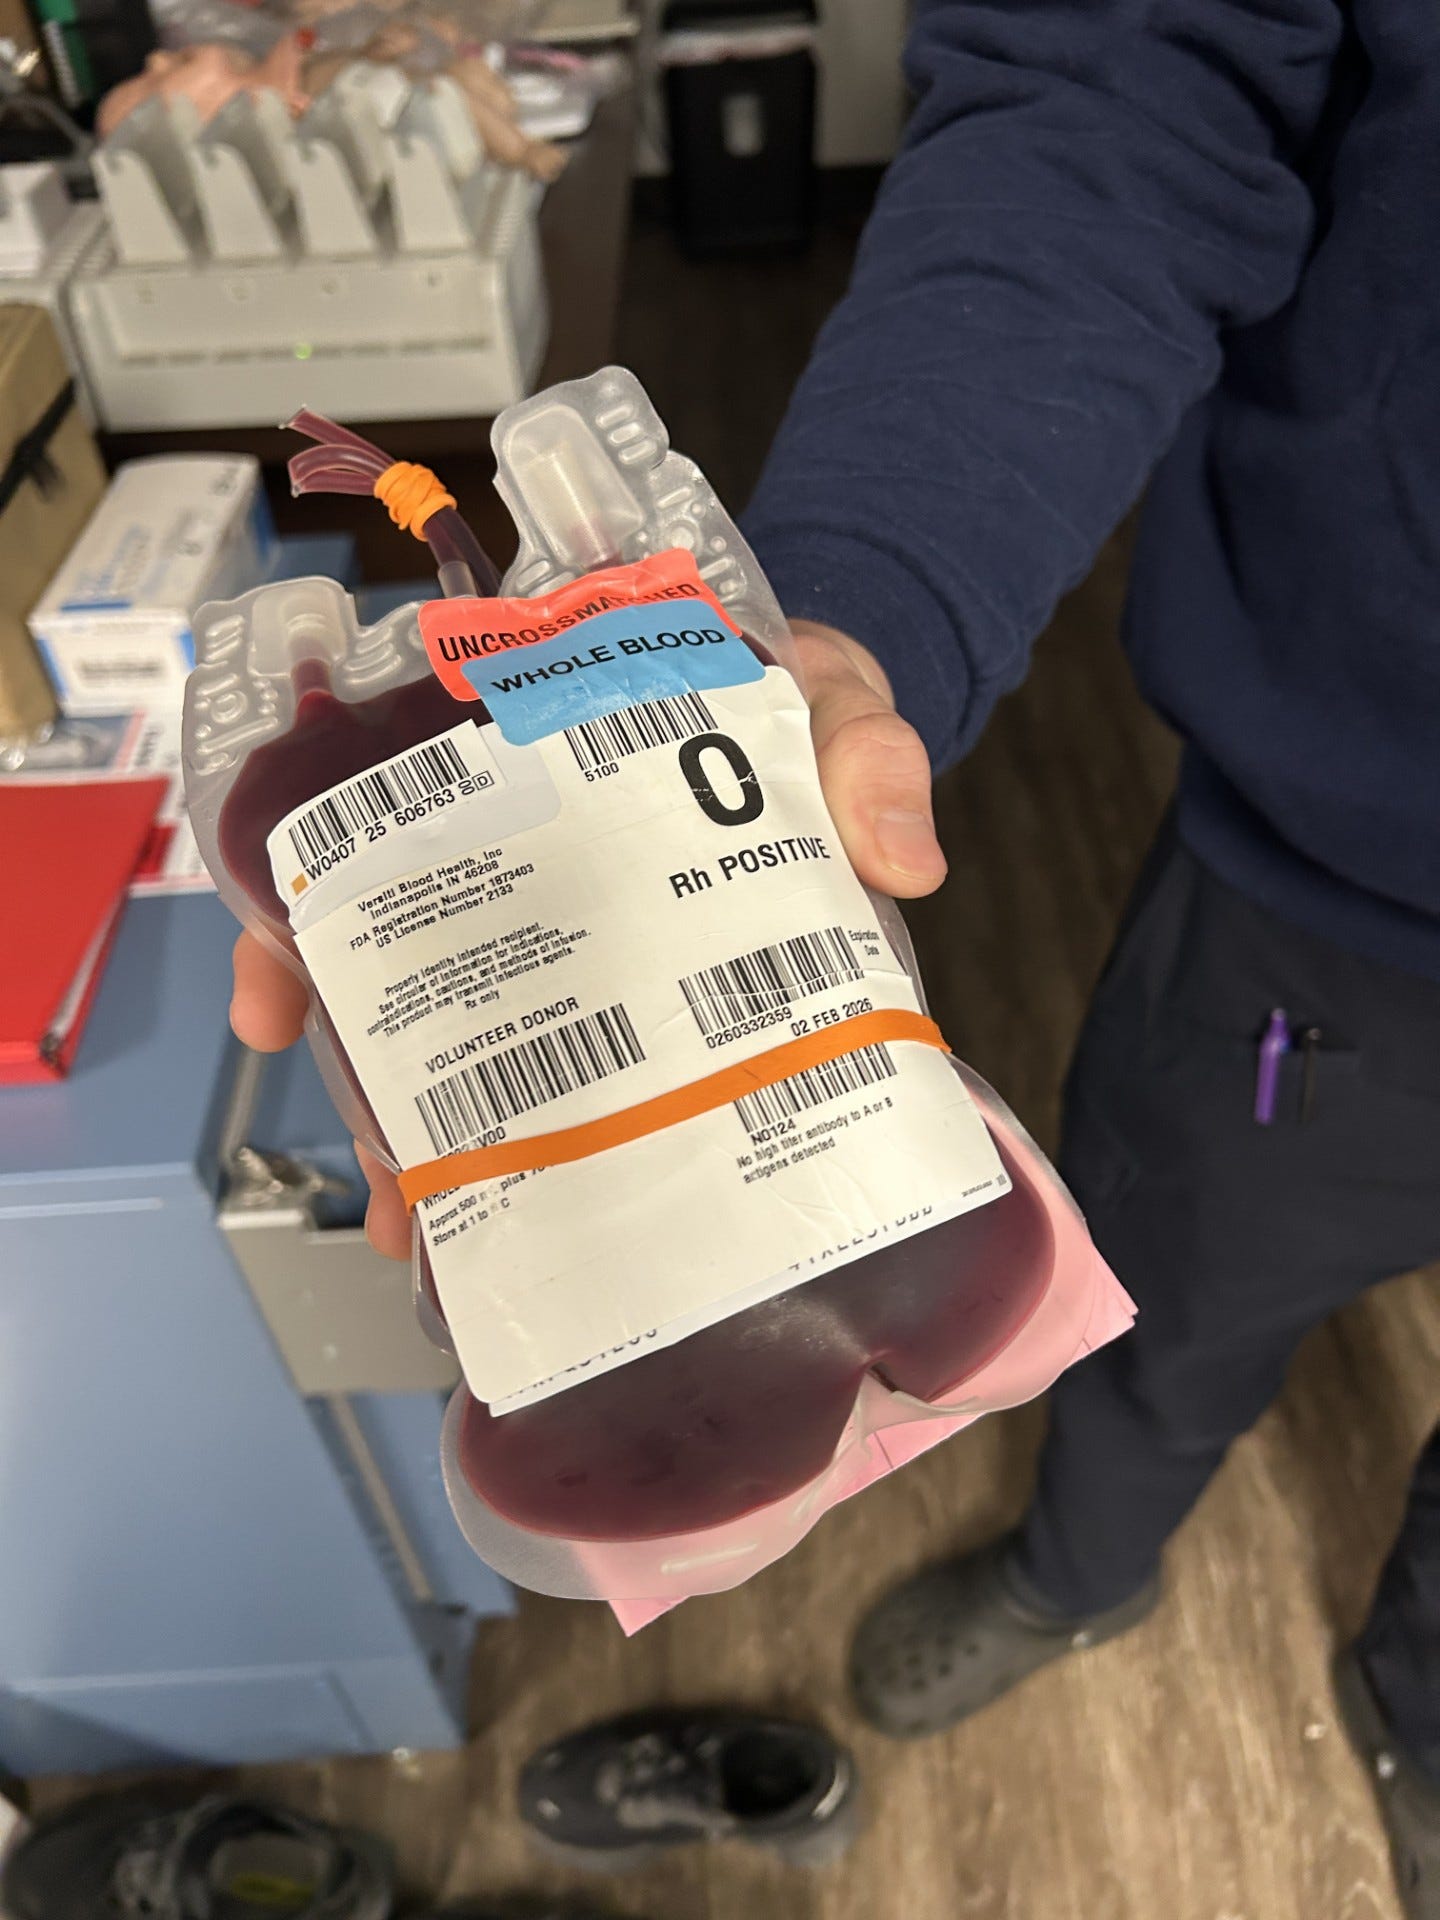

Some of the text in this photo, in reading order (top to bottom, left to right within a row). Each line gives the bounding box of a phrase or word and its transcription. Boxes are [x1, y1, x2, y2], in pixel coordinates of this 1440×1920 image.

[491, 628, 727, 693] WHOLE BLOOD
[584, 761, 620, 782] 5100
[306, 838, 358, 881] W0407
[365, 820, 388, 843] 25
[394, 788, 456, 827] 606763
[358, 888, 396, 913] Versiti
[399, 873, 434, 894] Blood
[483, 848, 503, 861] Inc
[370, 859, 500, 920] Indianapolis IN 46208
[669, 836, 831, 899] Rh POSITIVE
[350, 863, 535, 951] FDA Registration Number 1873403
[376, 883, 514, 949] US License Number 2133
[378, 1000, 395, 1015] See
[395, 982, 427, 1006] circular
[429, 975, 440, 989] of
[440, 954, 494, 987] information
[495, 946, 509, 960] for
[384, 968, 420, 998] Properly
[420, 956, 457, 980] identify
[457, 938, 499, 963] intended
[479, 962, 497, 979] and
[499, 948, 539, 970] methods
[539, 942, 552, 957] of
[383, 1022, 401, 1038] This
[401, 1004, 434, 1031] product
[435, 996, 455, 1011] may
[455, 976, 494, 1001] transmit
[495, 960, 541, 984] infectious
[464, 988, 501, 1011] Rx only
[705, 1006, 793, 1050] 0260332359
[790, 997, 874, 1037] 02 FEB 2026
[425, 996, 580, 1074] VOLUNTEER DONOR
[736, 1155, 753, 1169] No
[754, 1143, 780, 1160] high
[780, 1132, 803, 1152] titer
[805, 1114, 849, 1141] antibody
[850, 1108, 862, 1121] to
[863, 1104, 873, 1117] A
[873, 1100, 884, 1113] or
[750, 1117, 797, 1146] N0124
[790, 1136, 837, 1164] detected
[428, 1207, 460, 1231] Approx
[458, 1194, 478, 1212] 500
[500, 1171, 527, 1192] plus
[432, 1224, 458, 1247] Store
[458, 1219, 469, 1233] at
[468, 1215, 477, 1226] 1
[477, 1208, 490, 1221] to
[500, 1197, 511, 1209] C
